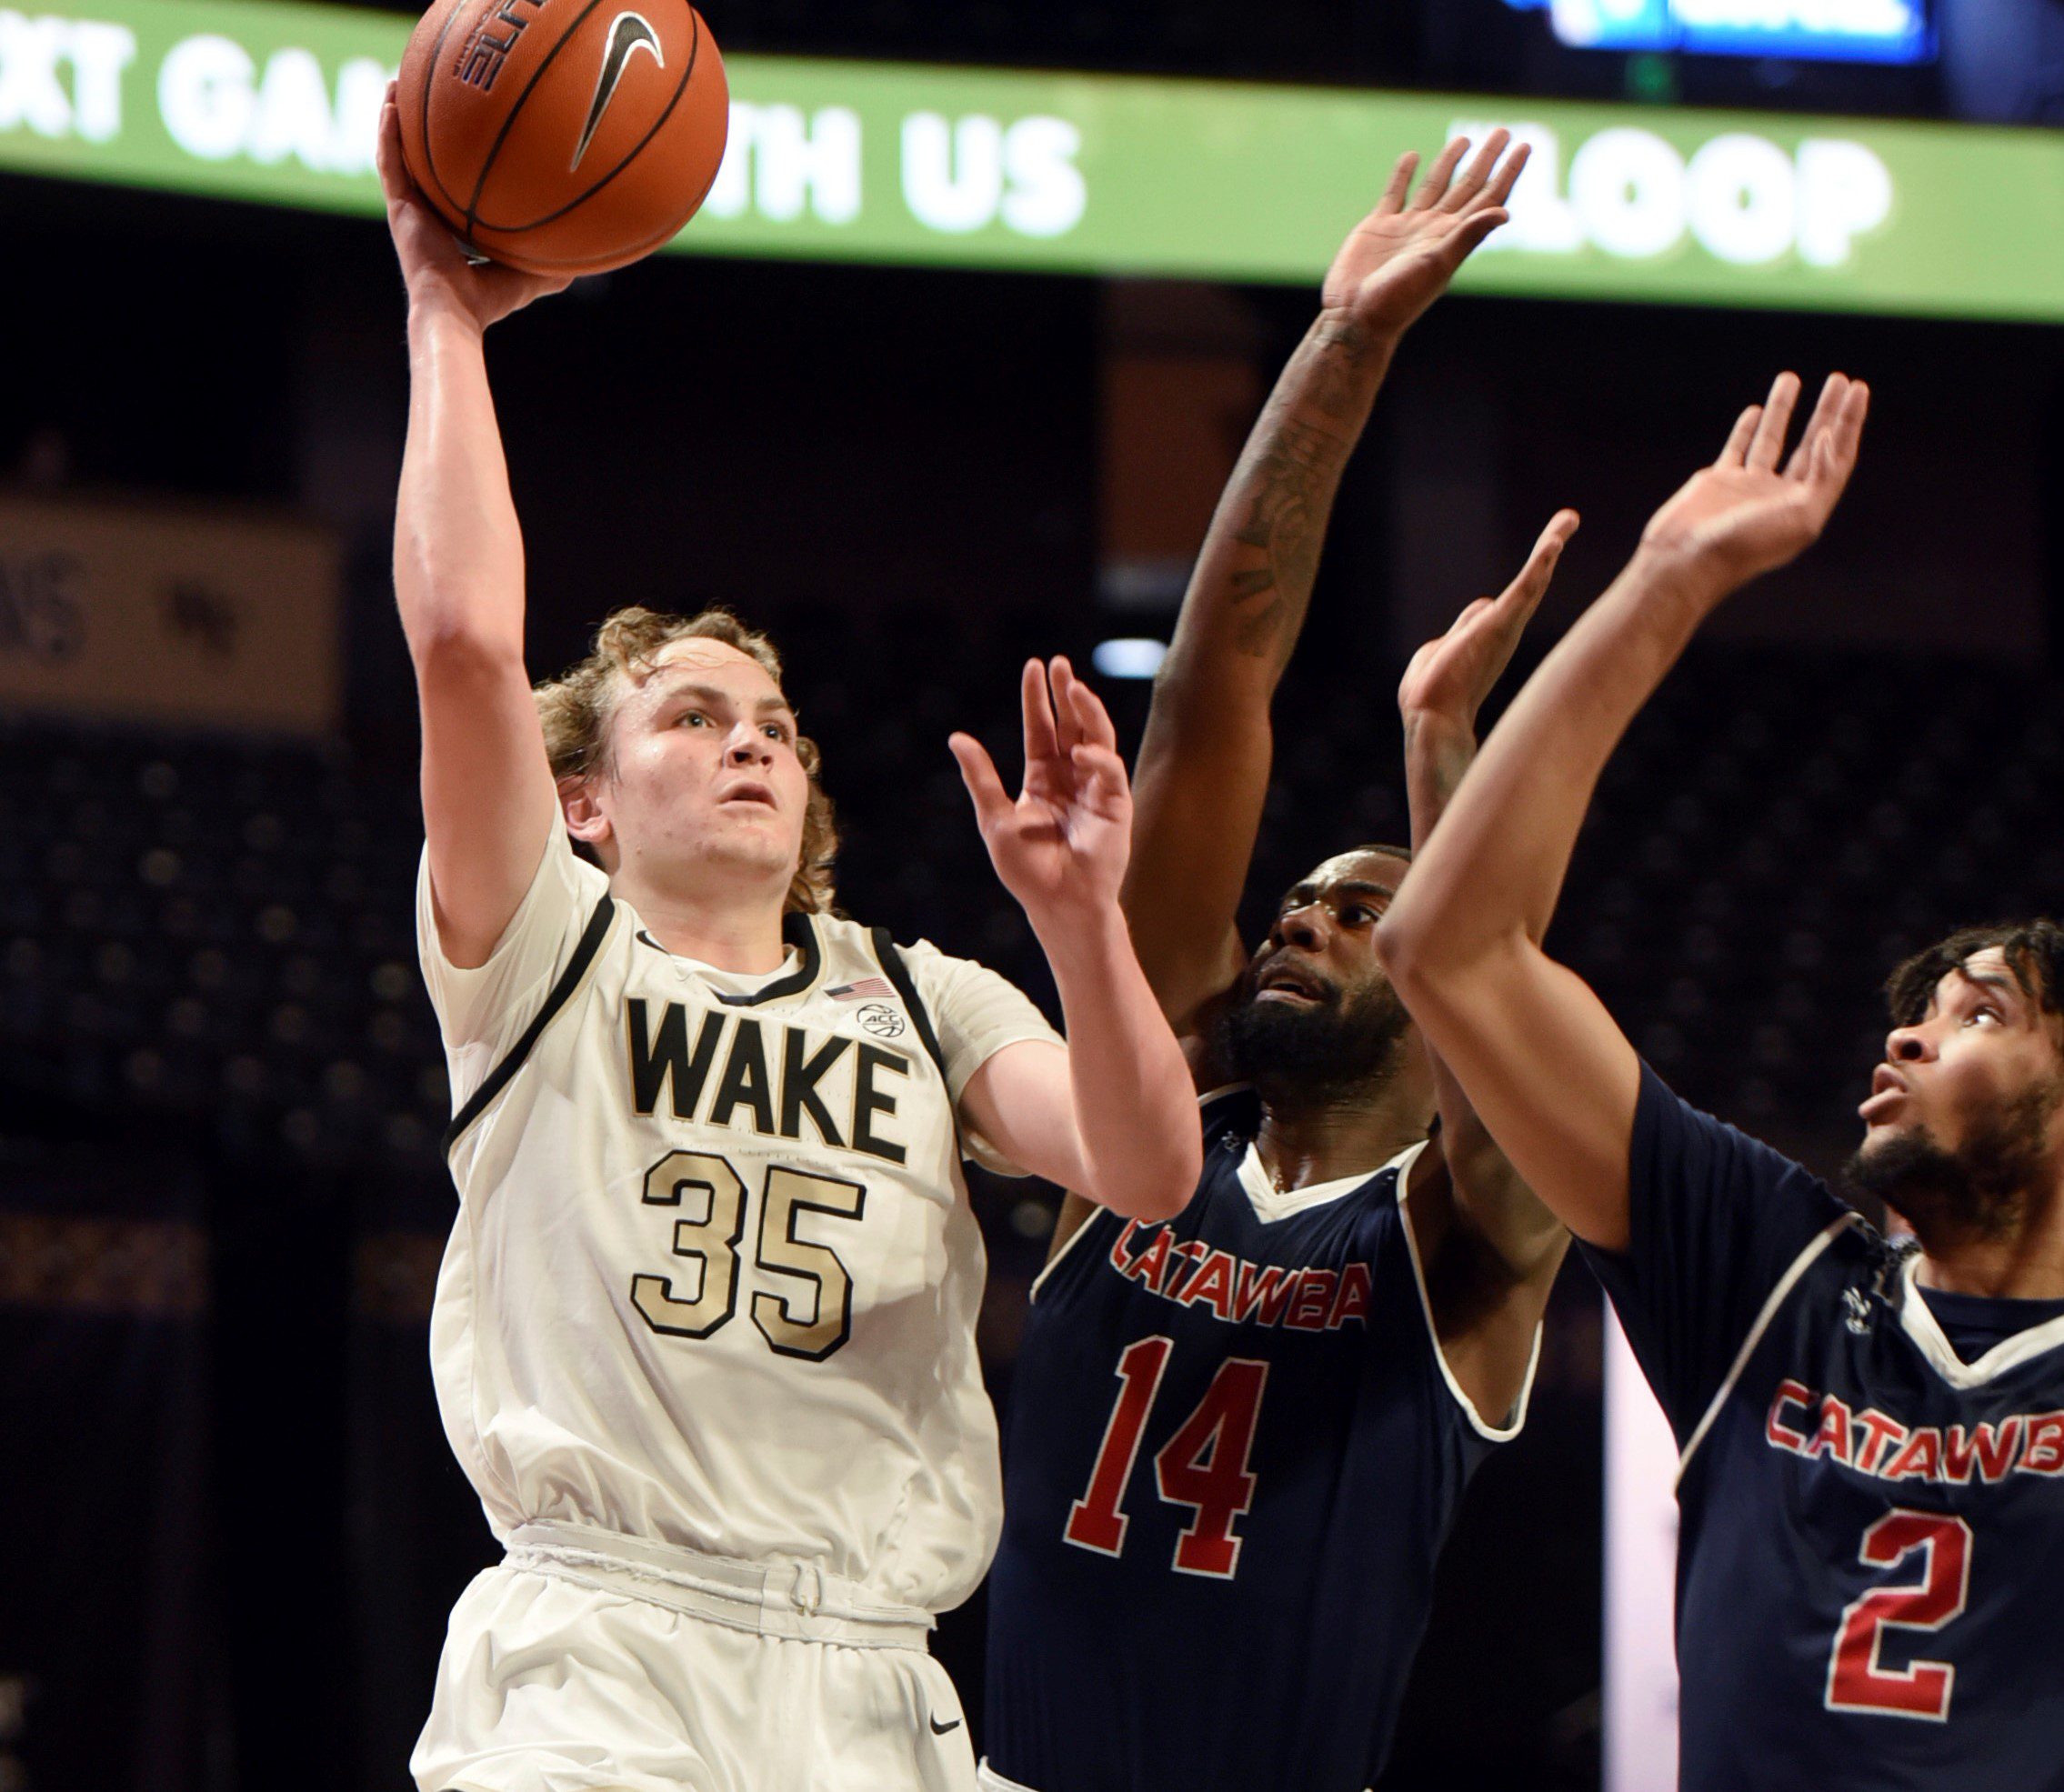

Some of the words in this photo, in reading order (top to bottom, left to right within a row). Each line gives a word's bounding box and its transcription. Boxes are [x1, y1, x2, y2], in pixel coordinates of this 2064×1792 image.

[702, 99, 862, 225] TH
[901, 111, 1087, 236] US
[626, 996, 909, 1167] WAKE
[864, 1015, 899, 1026] ACC
[630, 1149, 867, 1362] 35
[1109, 1215, 1374, 1333] CATAWBA
[1062, 1334, 1270, 1580] 14
[1765, 1378, 2064, 1485] CATAWB
[1824, 1507, 1973, 1723] 2
